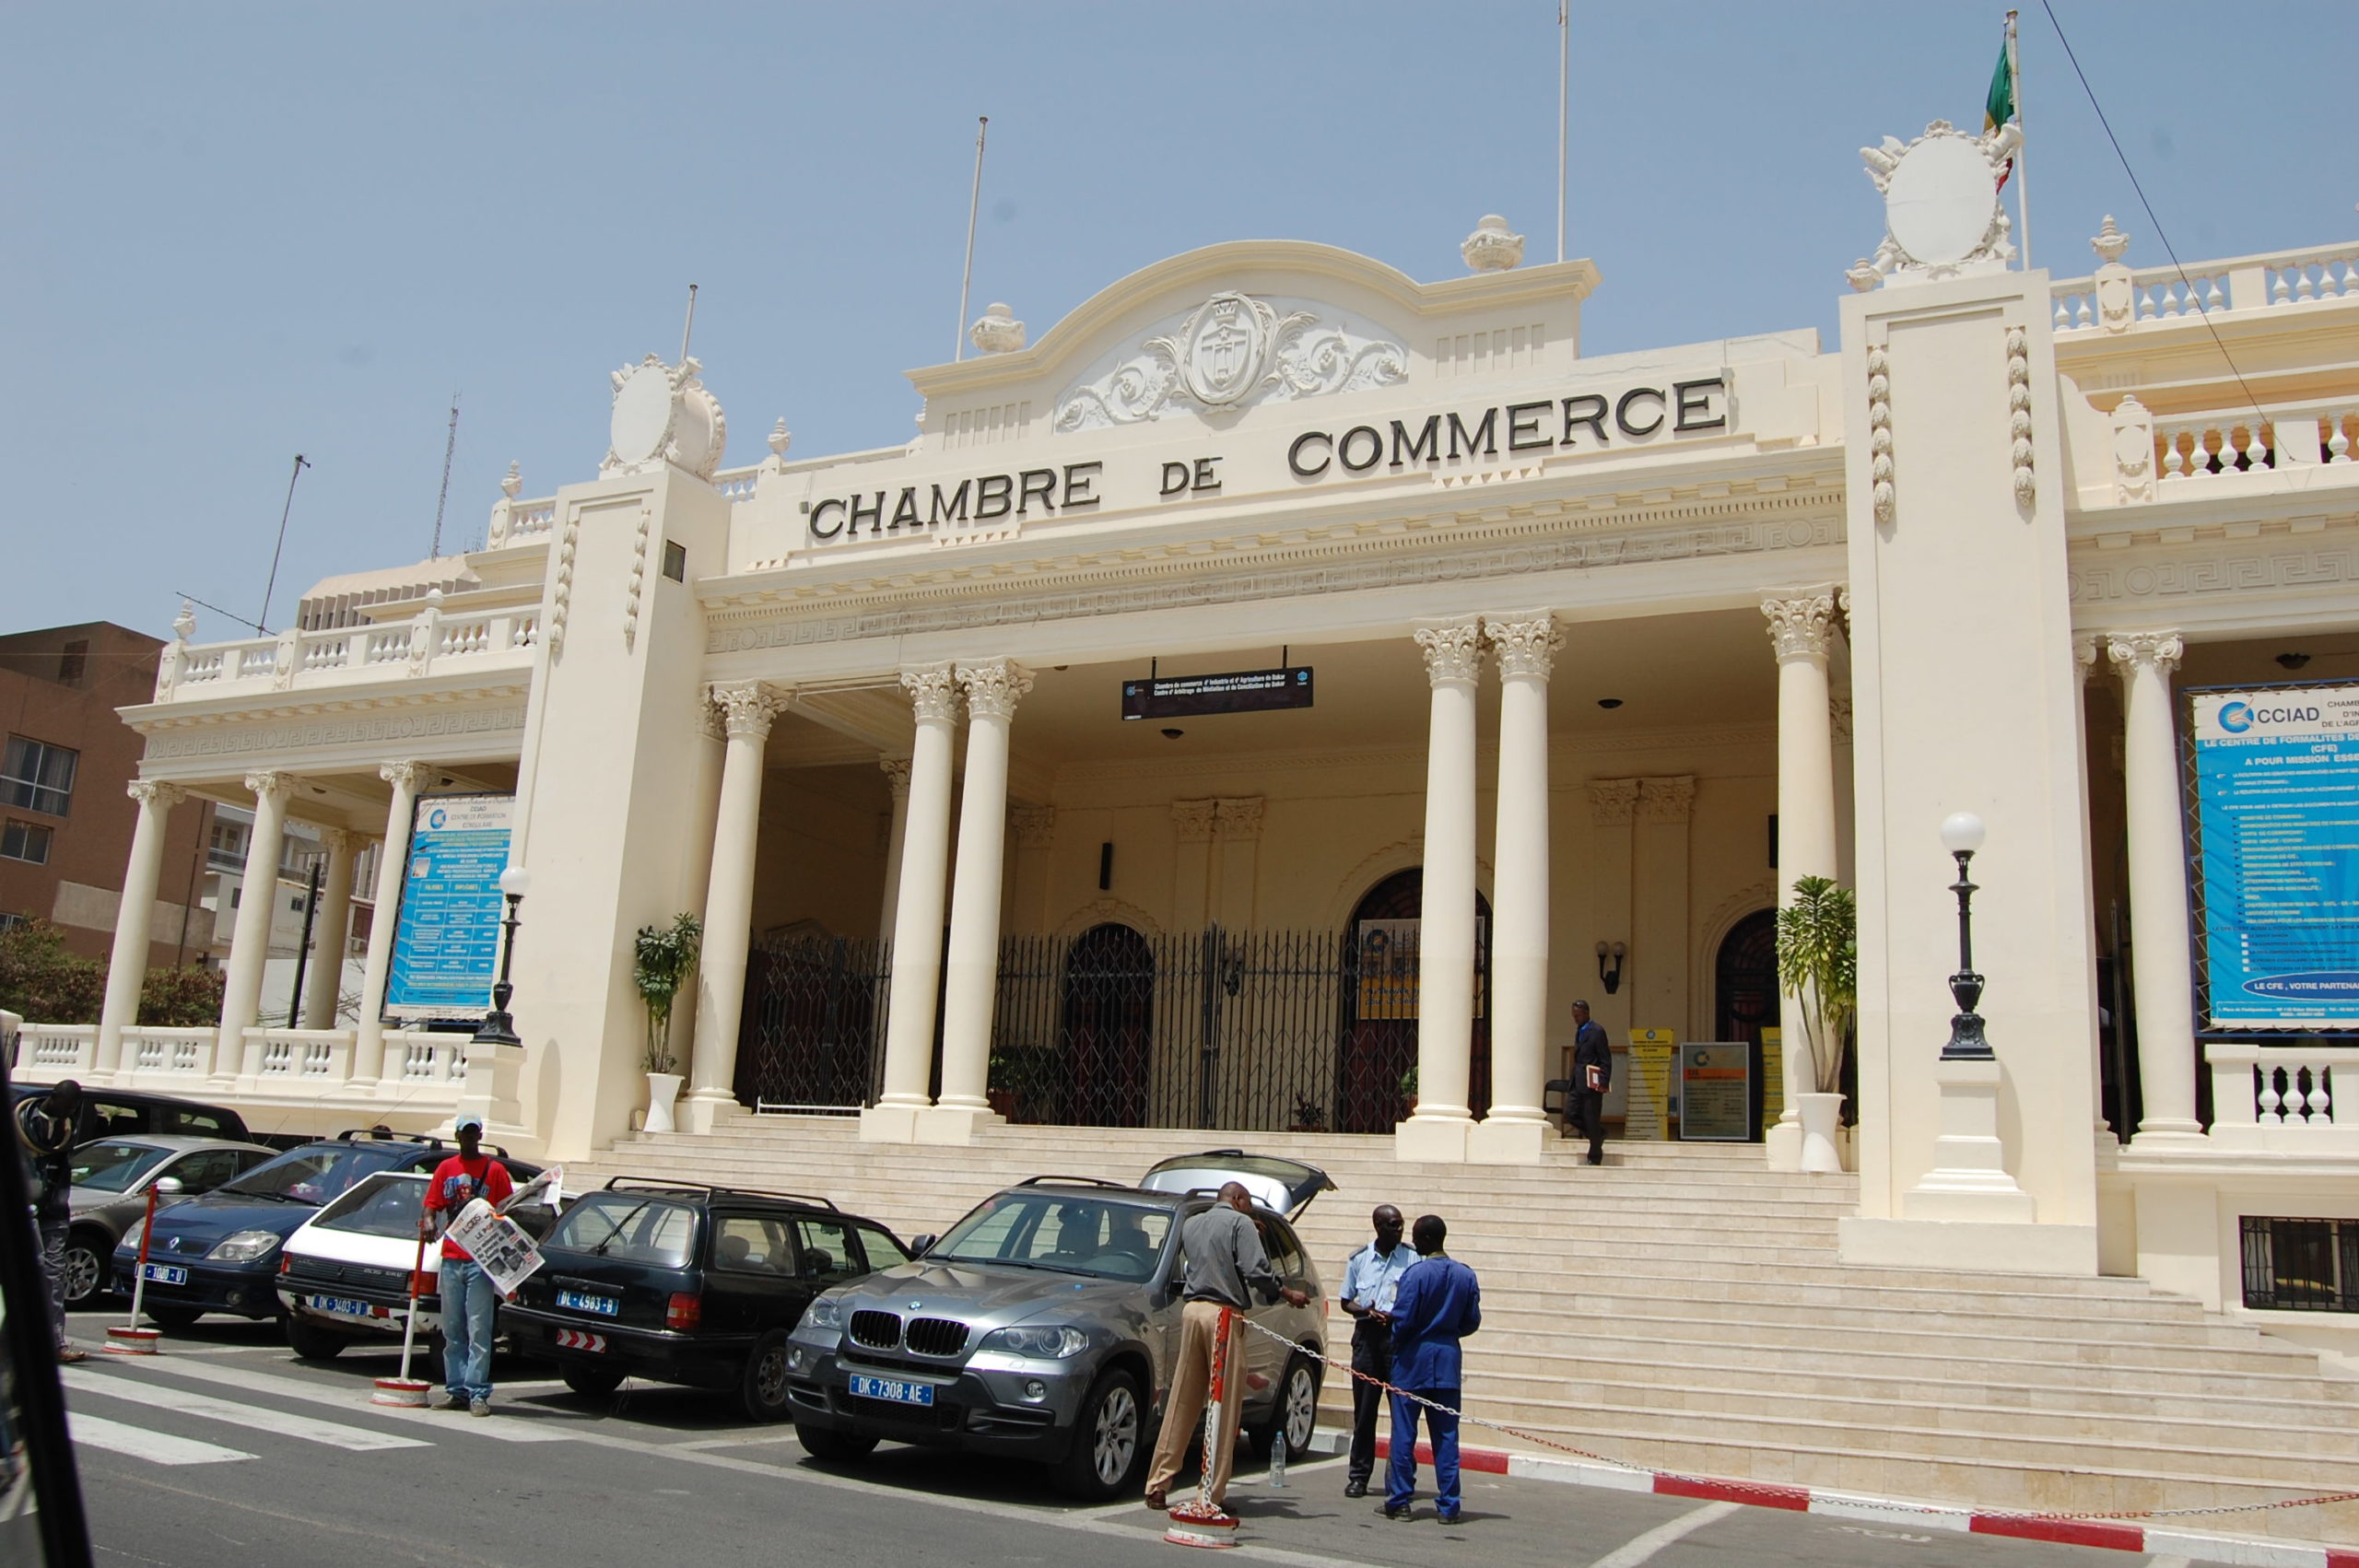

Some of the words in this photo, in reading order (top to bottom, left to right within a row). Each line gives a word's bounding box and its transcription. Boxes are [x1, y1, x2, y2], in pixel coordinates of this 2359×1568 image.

[810, 460, 1103, 539] CHAMBRE
[1159, 456, 1224, 496] DE
[1287, 377, 1726, 476] COMMERCE
[2258, 708, 2319, 724] CCIAD
[2220, 738, 2259, 747] CENTRE
[2263, 737, 2277, 745] DE
[2310, 744, 2339, 754] (CFE)
[2255, 756, 2283, 766] POUR
[2286, 755, 2330, 765] MISSION
